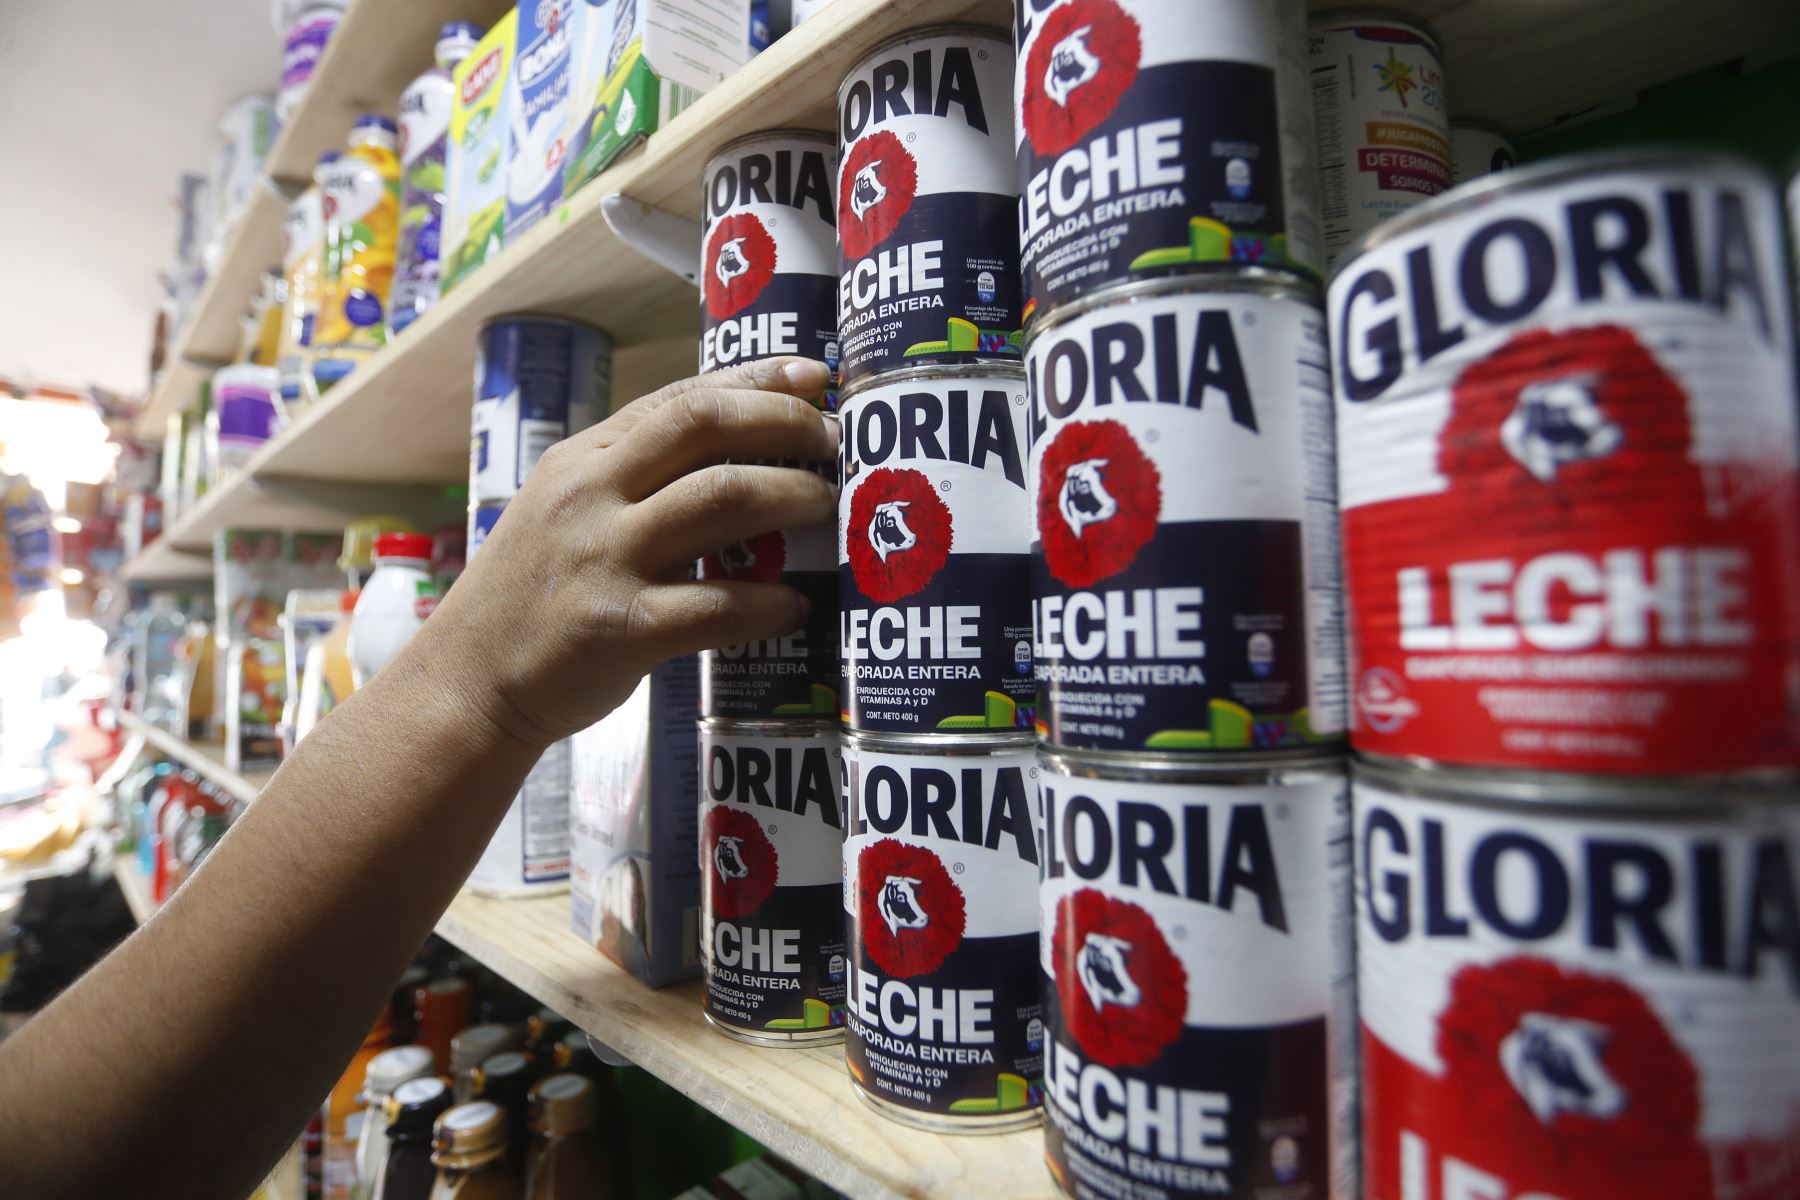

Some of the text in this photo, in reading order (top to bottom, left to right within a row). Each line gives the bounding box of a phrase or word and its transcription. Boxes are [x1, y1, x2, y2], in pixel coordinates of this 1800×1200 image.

[837, 47, 990, 161] LORIA
[702, 150, 837, 233] LORIA
[1018, 118, 1185, 255] LECHE
[1093, 187, 1186, 224] ENTERA
[1099, 223, 1129, 240] CON
[836, 240, 944, 331] LECHE
[1339, 188, 1778, 404] GLORIA
[879, 294, 944, 318] ENTERA
[883, 320, 903, 332] CON
[1028, 309, 1261, 446] LORIA
[1397, 546, 1752, 651] LECHE
[841, 605, 981, 660] LECHE
[1033, 586, 1205, 661] LECHE
[748, 662, 808, 675] ENTERA
[841, 664, 982, 680] EVAPORADA ENTERA
[1107, 664, 1206, 686] ENTERA
[856, 686, 936, 697] ENRIQUECIDA CON
[860, 696, 902, 706] VITAMINAS
[904, 696, 911, 706] A
[920, 696, 929, 706] D
[1113, 692, 1146, 707] CON
[866, 710, 882, 721] CONT.
[882, 712, 900, 722] NETO
[900, 712, 914, 722] 400
[710, 745, 842, 831] ORIA
[1364, 806, 1800, 1003] GLORIA
[742, 974, 801, 990] ENTERA
[746, 992, 764, 1002] CON
[846, 958, 995, 1044] LECHE
[846, 1011, 995, 1064] EVAPORADA ENTERA
[866, 1048, 948, 1080] ENRIQUECIDA CON
[869, 1060, 914, 1084] VITAMINAS
[933, 1078, 941, 1088] D
[894, 1085, 912, 1098] NETO
[912, 1090, 926, 1101] 400
[1043, 1021, 1231, 1168] LECHE
